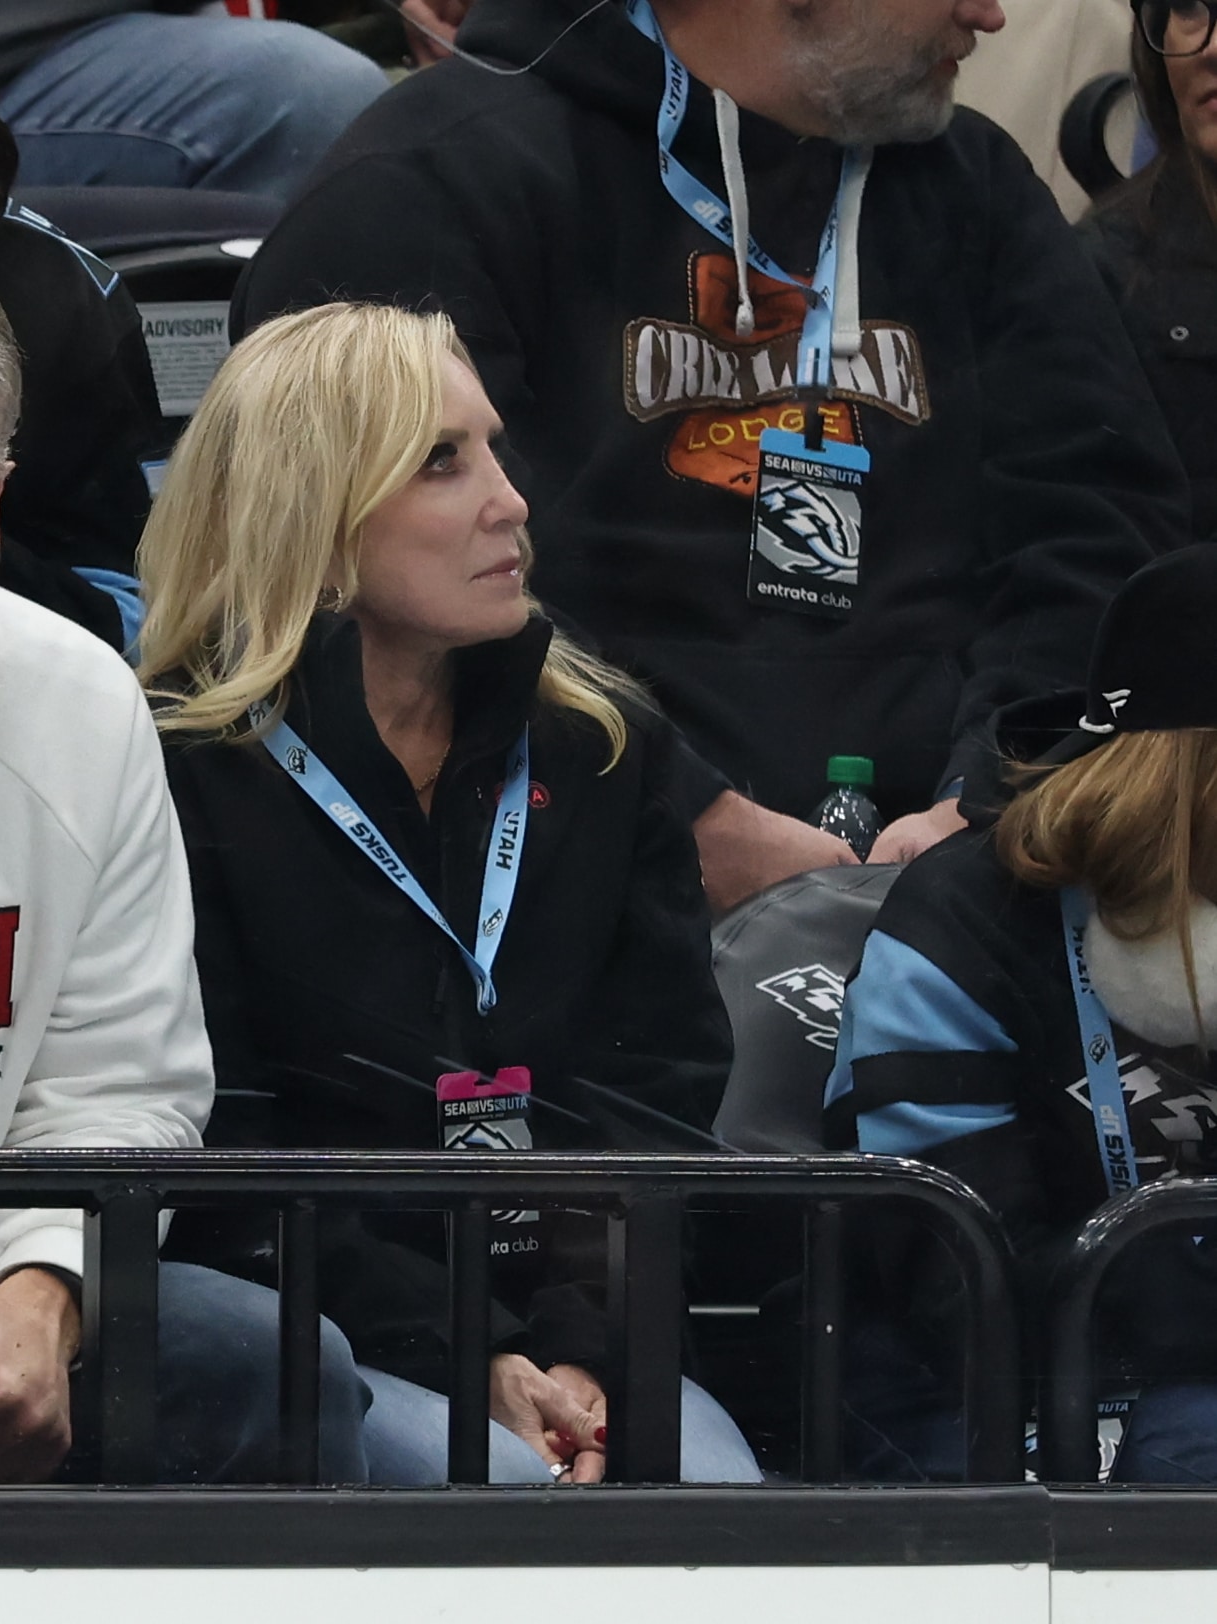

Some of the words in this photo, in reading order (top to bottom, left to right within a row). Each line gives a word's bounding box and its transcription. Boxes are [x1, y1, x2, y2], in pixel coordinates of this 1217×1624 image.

[666, 59, 682, 121] UTAH
[144, 318, 224, 337] ADVISORY
[751, 329, 920, 418] LKE
[689, 407, 840, 450] LODGE
[765, 455, 790, 471] SEA
[806, 462, 822, 477] VS
[838, 470, 862, 485] UTA
[757, 582, 818, 603] entrata
[821, 592, 852, 609] club
[496, 811, 520, 870] UTAH
[444, 1101, 467, 1117] SEA
[480, 1099, 494, 1113] VS
[507, 1096, 529, 1110] UTA
[512, 1236, 539, 1252] club
[1104, 1402, 1129, 1413] UTA
